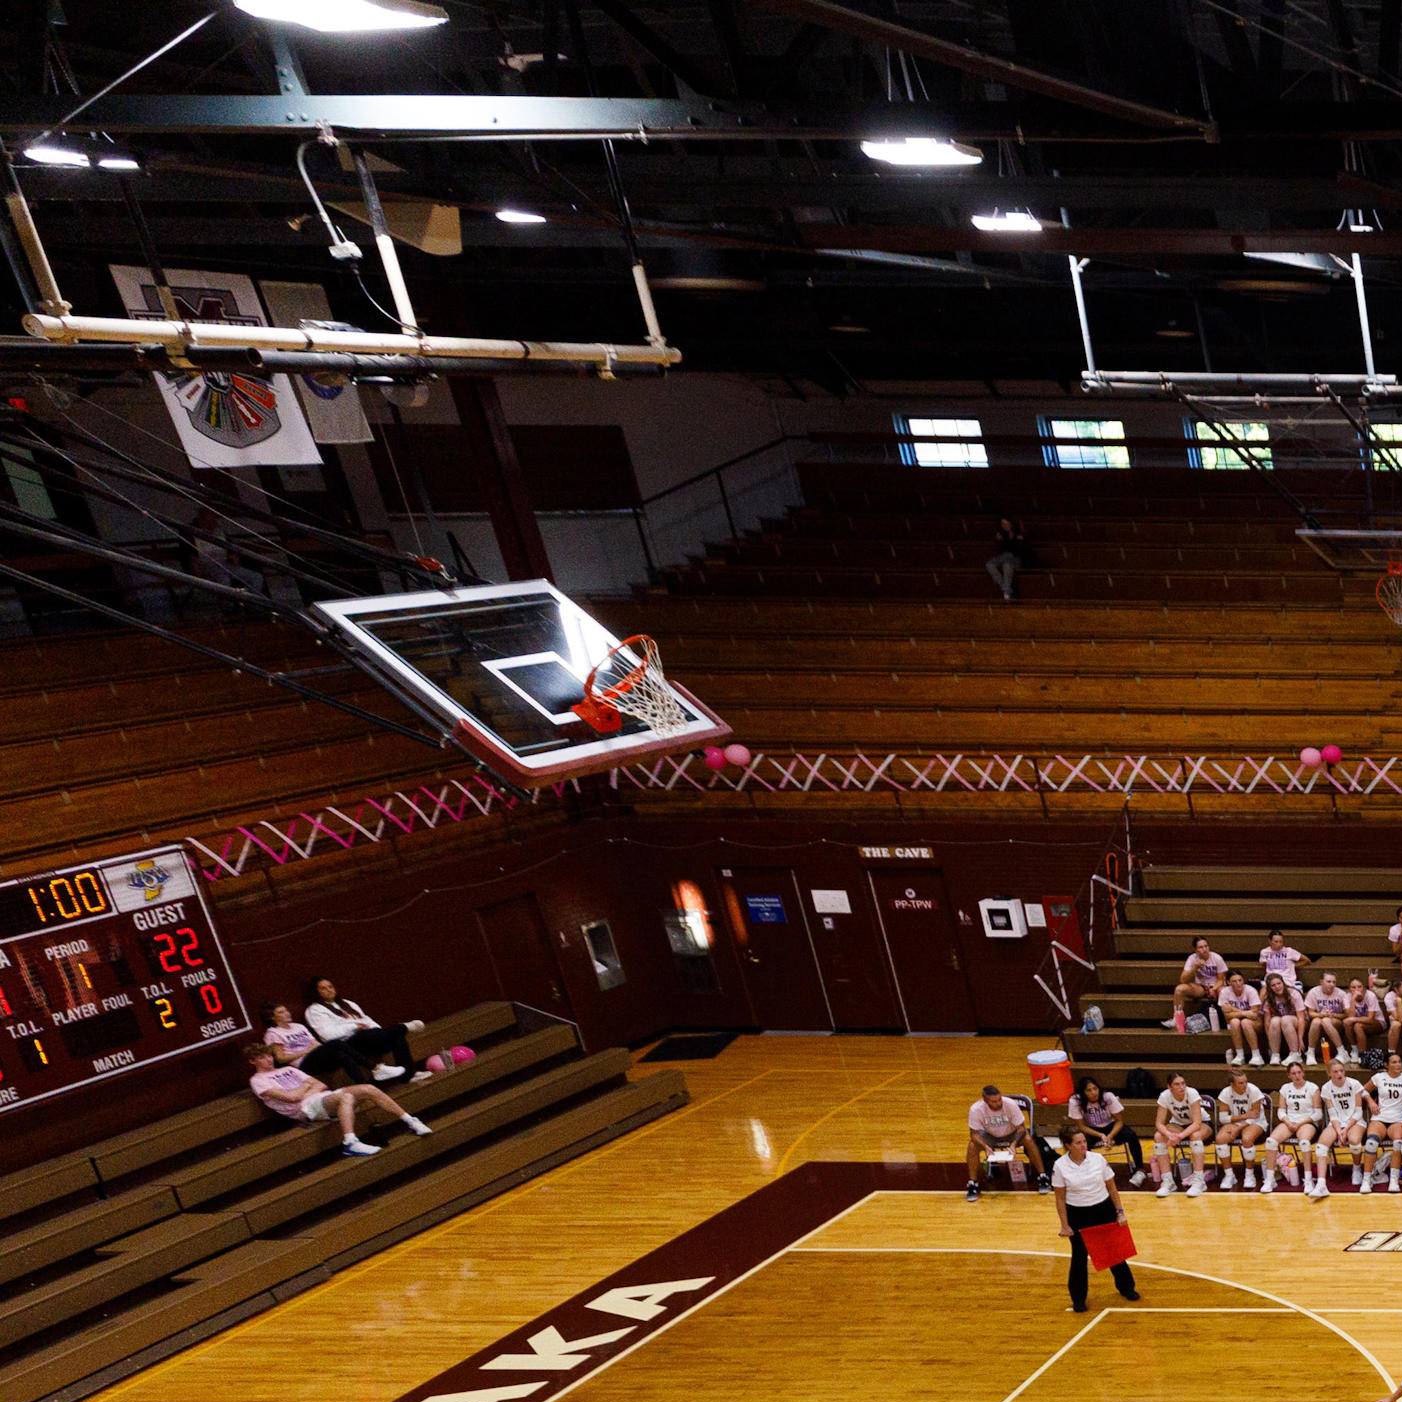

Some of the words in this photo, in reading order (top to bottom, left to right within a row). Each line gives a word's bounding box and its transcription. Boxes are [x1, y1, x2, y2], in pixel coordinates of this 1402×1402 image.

[862, 847, 891, 857] THE
[895, 847, 931, 859] CAVE
[28, 872, 107, 923] 1:00
[132, 902, 188, 931] GUEST
[44, 938, 90, 961] PERIOD
[153, 927, 205, 973] 22
[78, 962, 94, 990] 1
[180, 967, 218, 988] FOULS
[140, 981, 174, 1000] T.O.L.
[200, 983, 223, 1015] 0
[51, 1001, 99, 1027] PLAYER
[101, 992, 134, 1012] FOUL
[155, 998, 177, 1029] 2
[6, 1020, 44, 1040] T.O.L.
[200, 1016, 238, 1039] SCORE
[34, 1038, 49, 1065] 1
[92, 1049, 136, 1074] MATCH
[1332, 1092, 1353, 1100] PENN
[1338, 1099, 1350, 1110] 15
[1388, 1088, 1400, 1100] 10
[1293, 1101, 1300, 1112] 3
